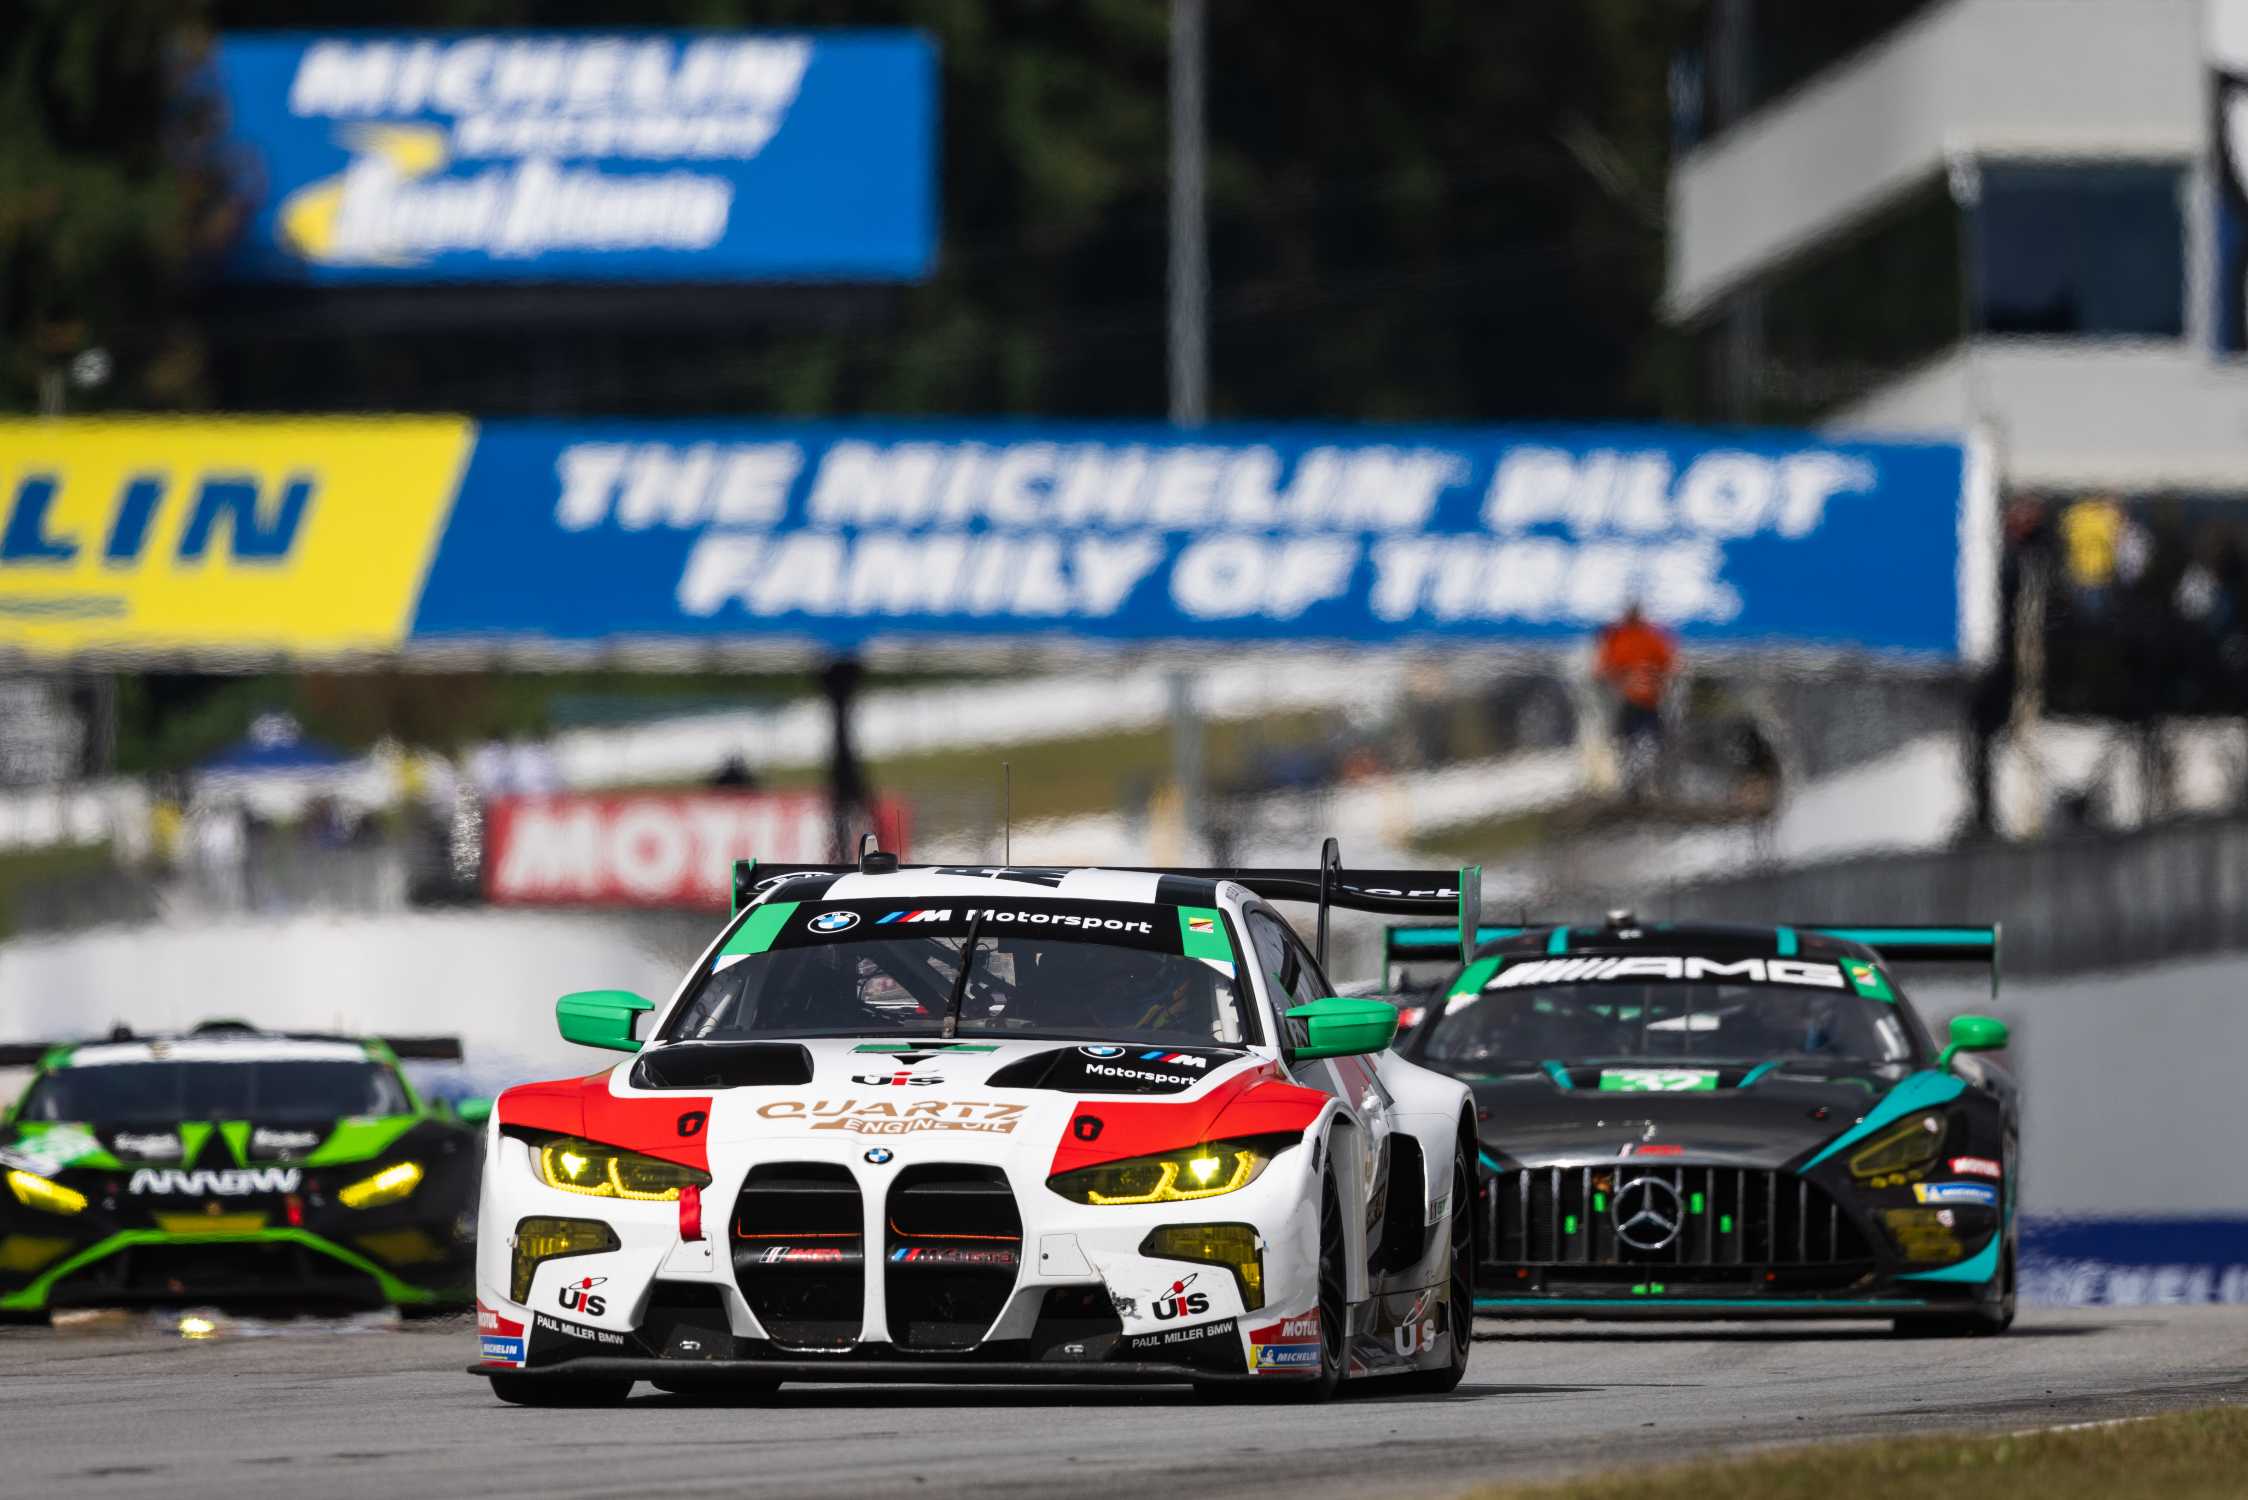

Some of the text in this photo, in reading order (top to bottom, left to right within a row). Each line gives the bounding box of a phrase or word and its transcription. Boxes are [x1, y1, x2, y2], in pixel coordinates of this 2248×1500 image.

[555, 441, 1877, 539] THE MICHELIN PILOT
[676, 532, 1165, 616] FAMILY
[1171, 533, 1361, 618] OF
[966, 909, 1153, 934] Motorsport
[1598, 955, 1846, 988] AMG
[1085, 1063, 1197, 1086] Motorsport
[756, 1100, 1029, 1119] QUARTZ
[844, 1117, 1007, 1133] ENGINE OIL
[536, 1315, 625, 1345] PAUL MILLER BMW
[1132, 1321, 1233, 1348] PAUL MILLER BMW
[1282, 1319, 1319, 1337] MOTUL
